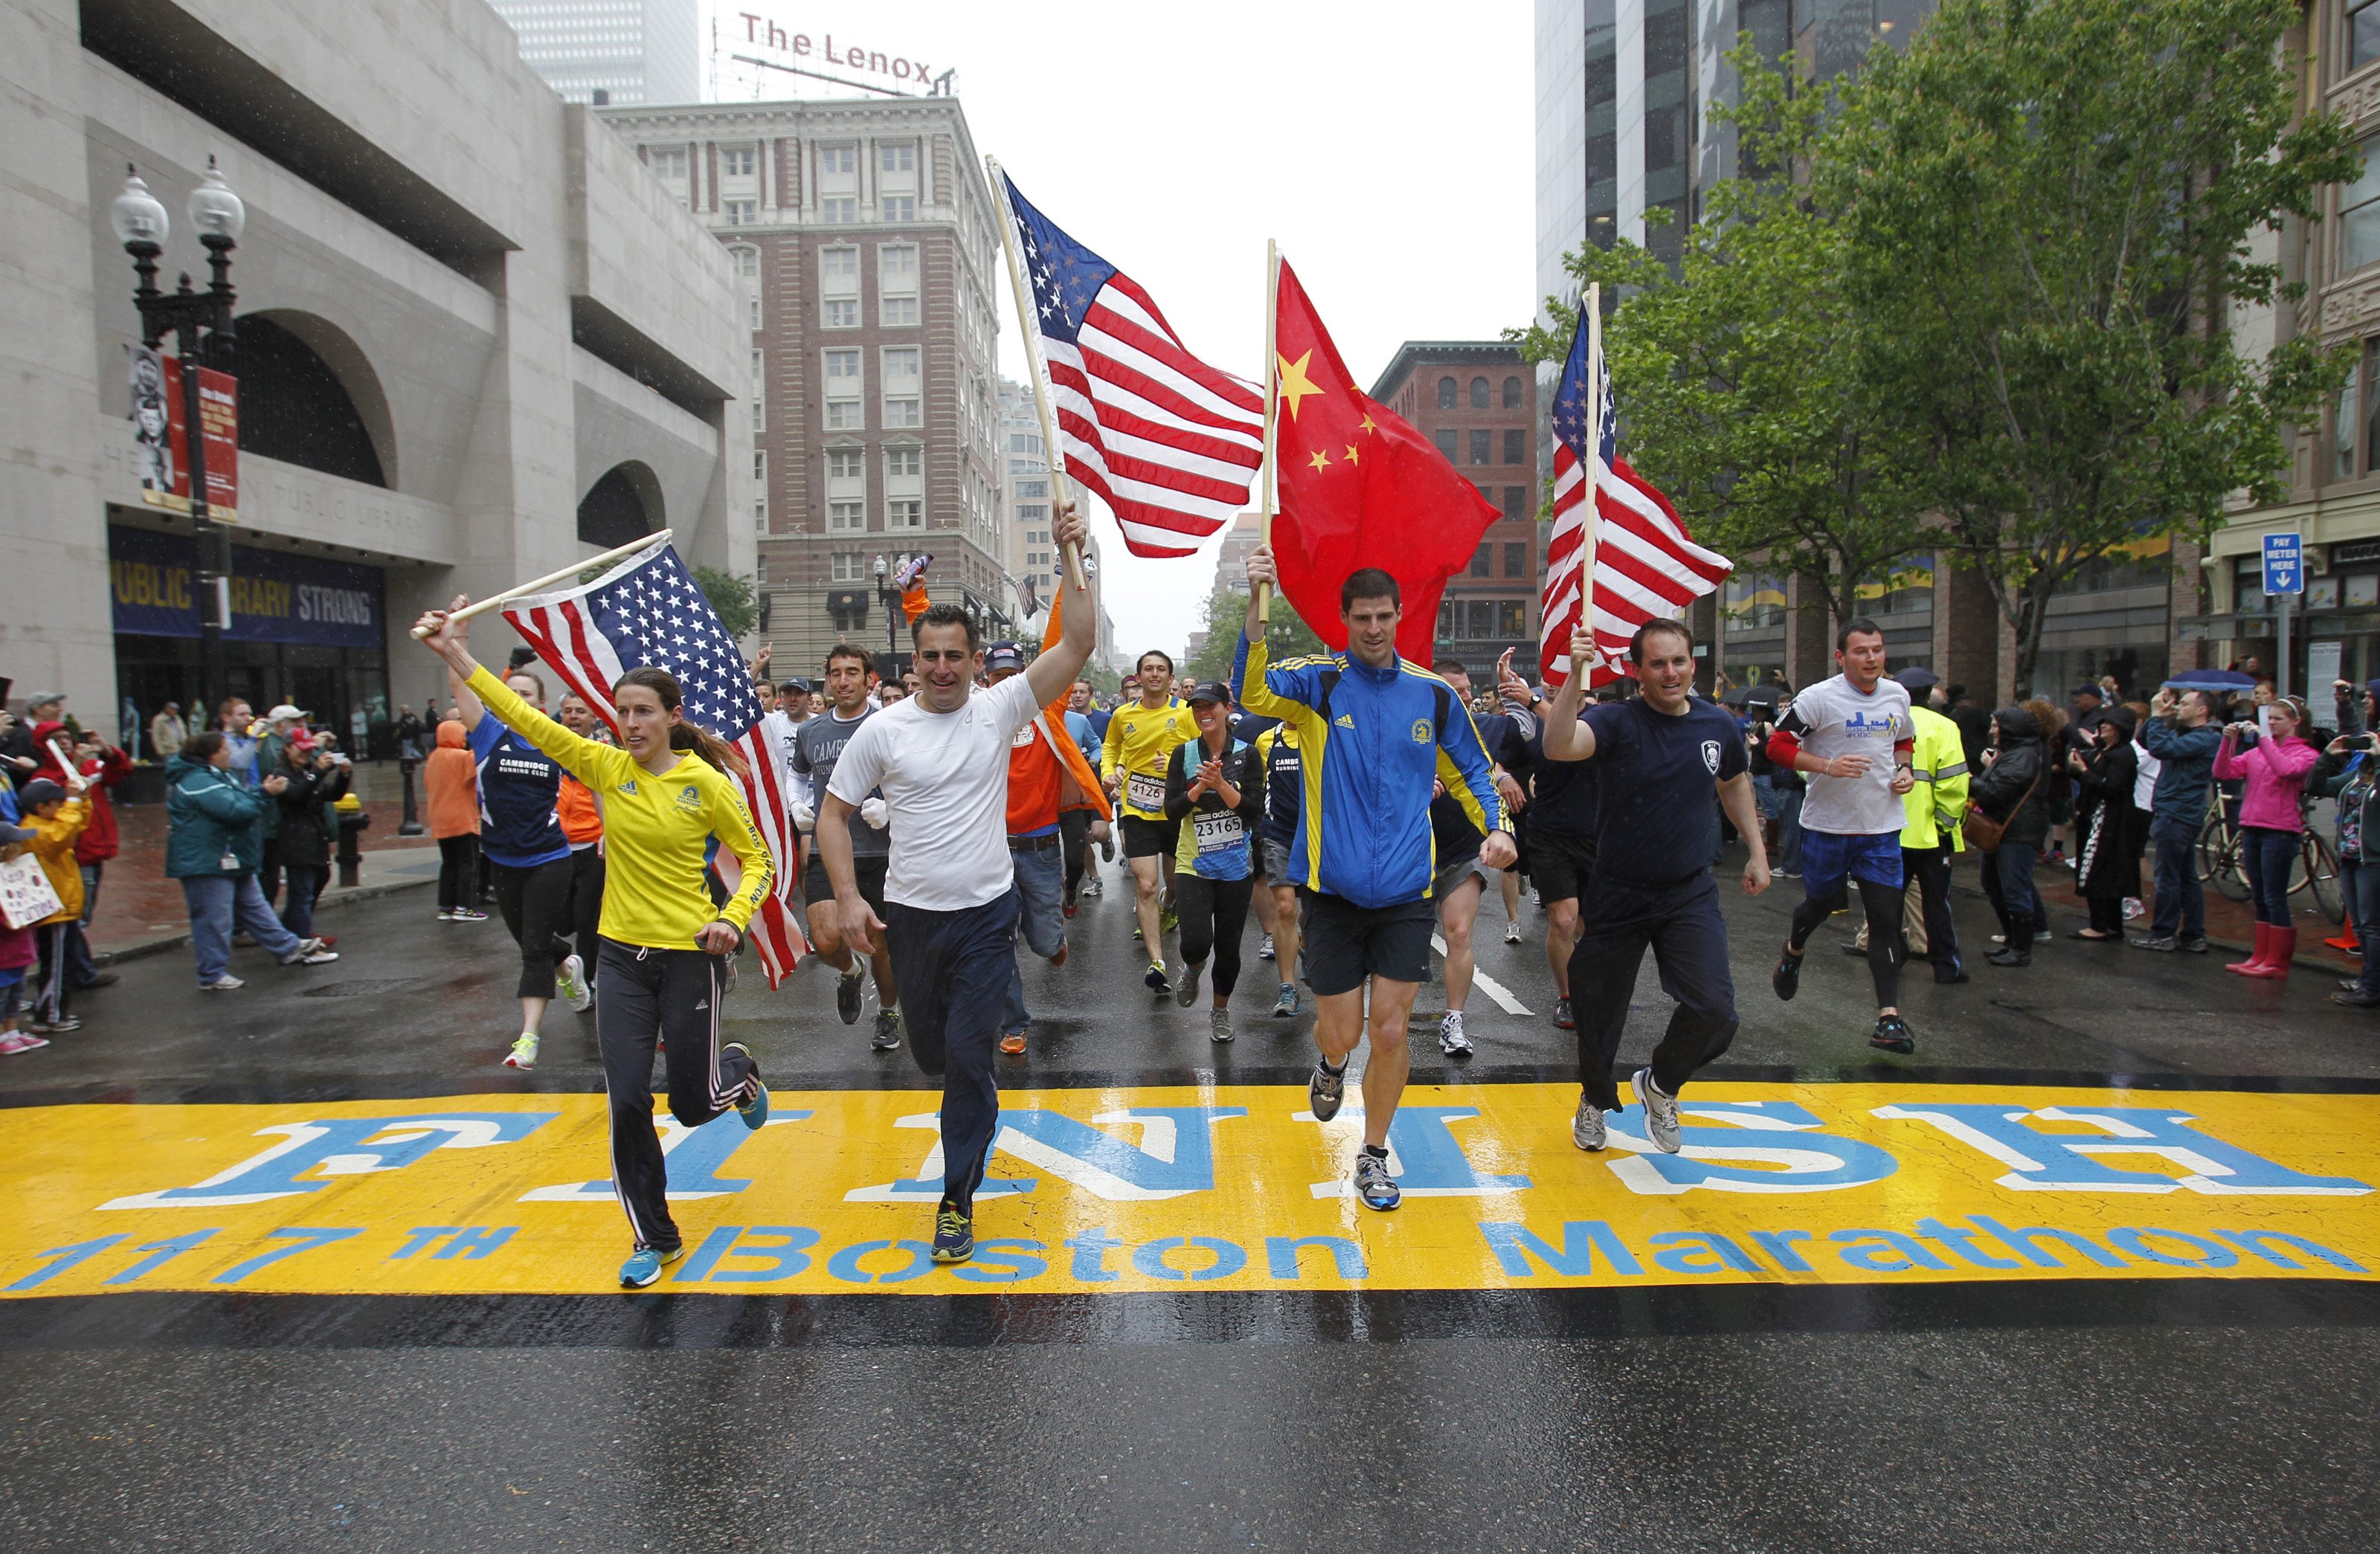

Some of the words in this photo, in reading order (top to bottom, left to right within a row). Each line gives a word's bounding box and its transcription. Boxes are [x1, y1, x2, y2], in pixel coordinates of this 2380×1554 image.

[740, 12, 811, 56] The
[826, 34, 931, 85] Lenox
[2273, 537, 2290, 547] PAY
[2266, 549, 2298, 559] METER
[2270, 560, 2296, 570] HERE
[298, 584, 370, 625] STRONG
[1334, 720, 1355, 729] adidas
[500, 758, 550, 772] CAMBRIDGE
[499, 767, 530, 775] RUNNING
[531, 770, 549, 778] CLUB
[1143, 777, 1166, 787] adidas
[1132, 784, 1160, 799] 4126
[736, 799, 751, 824] 2013
[1196, 817, 1241, 837] 23165
[94, 1101, 2378, 1210] FINISH
[672, 1225, 1368, 1283] Boston
[1477, 1214, 2372, 1277] Marathon
